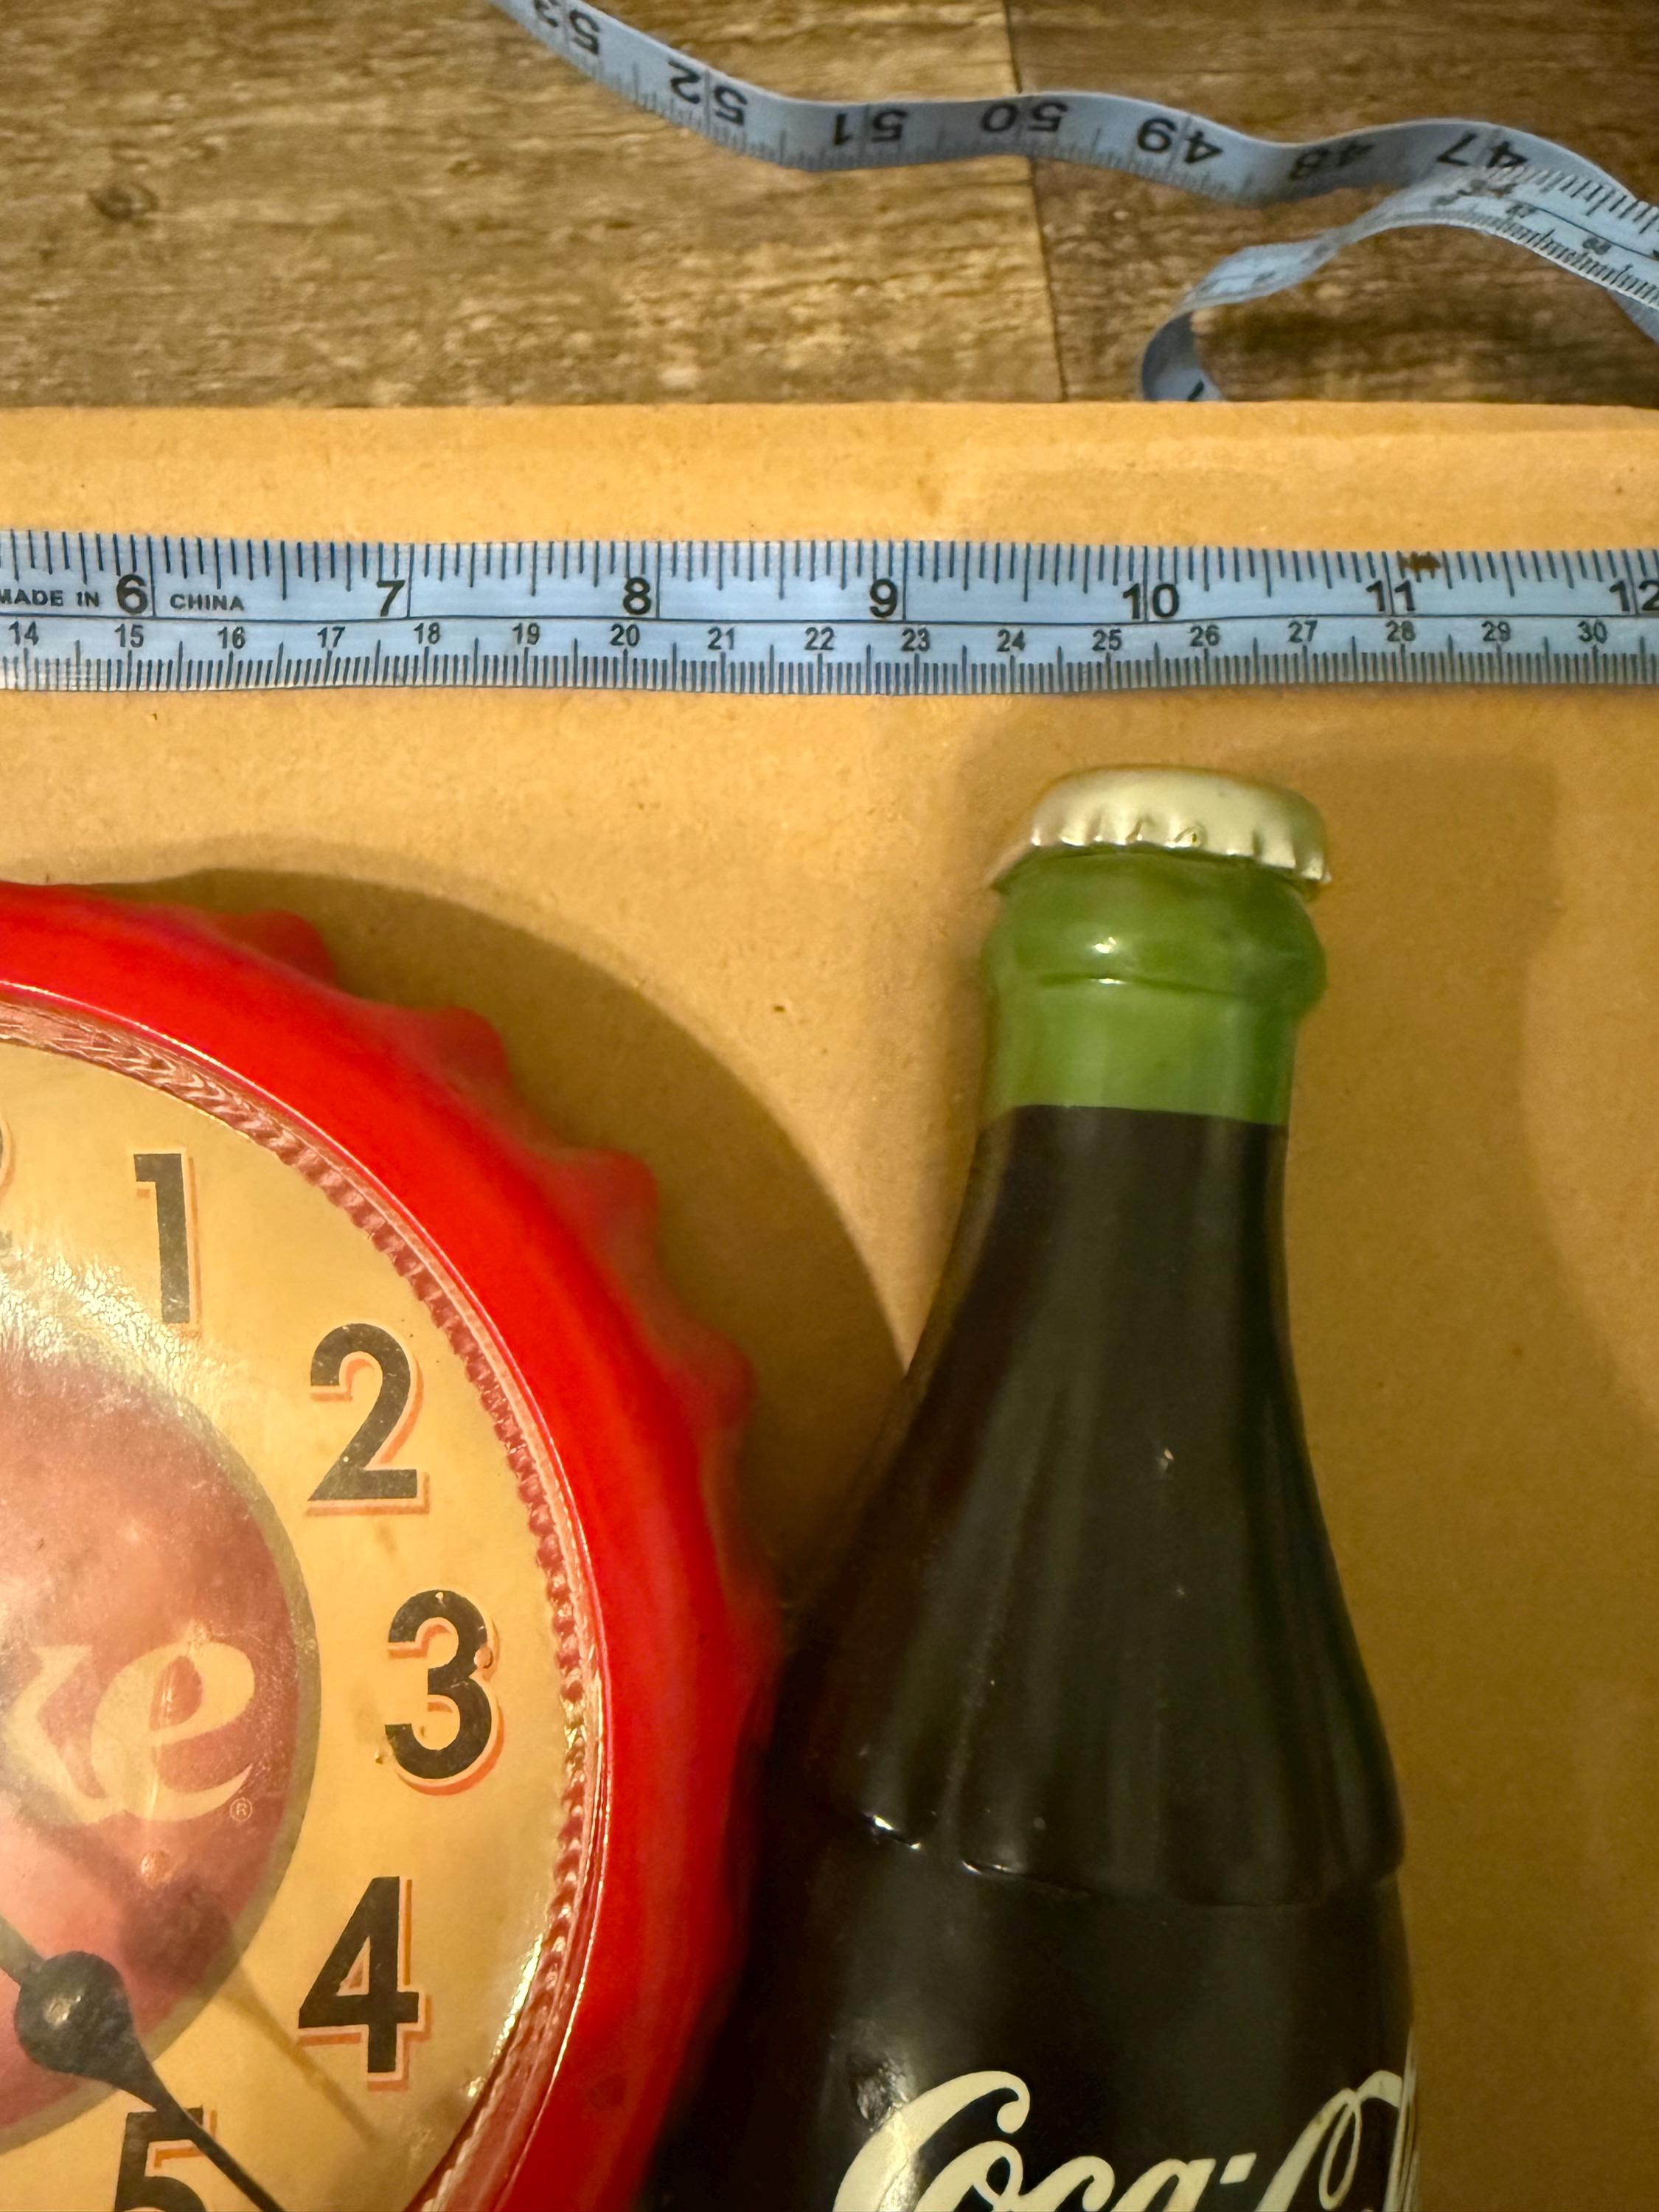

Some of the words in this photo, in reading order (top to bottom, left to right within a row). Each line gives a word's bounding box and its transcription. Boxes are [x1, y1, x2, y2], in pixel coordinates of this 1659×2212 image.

[667, 60, 748, 125] 52
[832, 108, 910, 146] 51
[980, 100, 1067, 133] 50
[1137, 116, 1223, 164] 49
[1437, 132, 1528, 168] 47
[0, 588, 63, 606] MADE
[77, 591, 100, 607] IN
[170, 594, 245, 611] CHINA
[116, 574, 147, 613] 6
[376, 579, 405, 616] 7
[622, 577, 652, 615] 8
[869, 578, 898, 618] 9
[1122, 582, 1180, 620] 10
[1366, 580, 1416, 612] 11
[1609, 580, 1659, 611] 12
[8, 622, 39, 646] 14
[114, 623, 145, 648] 15
[218, 626, 246, 649] 16
[317, 626, 346, 648] 17
[413, 622, 441, 644] 18
[512, 624, 540, 646] 19
[610, 624, 641, 647] 20
[707, 627, 735, 650] 21
[804, 627, 835, 651] 22
[901, 627, 931, 652] 23
[997, 628, 1026, 652] 24
[1092, 627, 1122, 651] 25
[1190, 625, 1220, 647] 26
[1287, 619, 1318, 643] 27
[1385, 620, 1416, 642] 28
[1481, 620, 1511, 642] 29
[1577, 620, 1608, 644] 30
[133, 1153, 195, 1326] 1
[307, 1323, 424, 1508] 2
[385, 1589, 498, 1787] 3
[299, 1876, 425, 2082] 4
